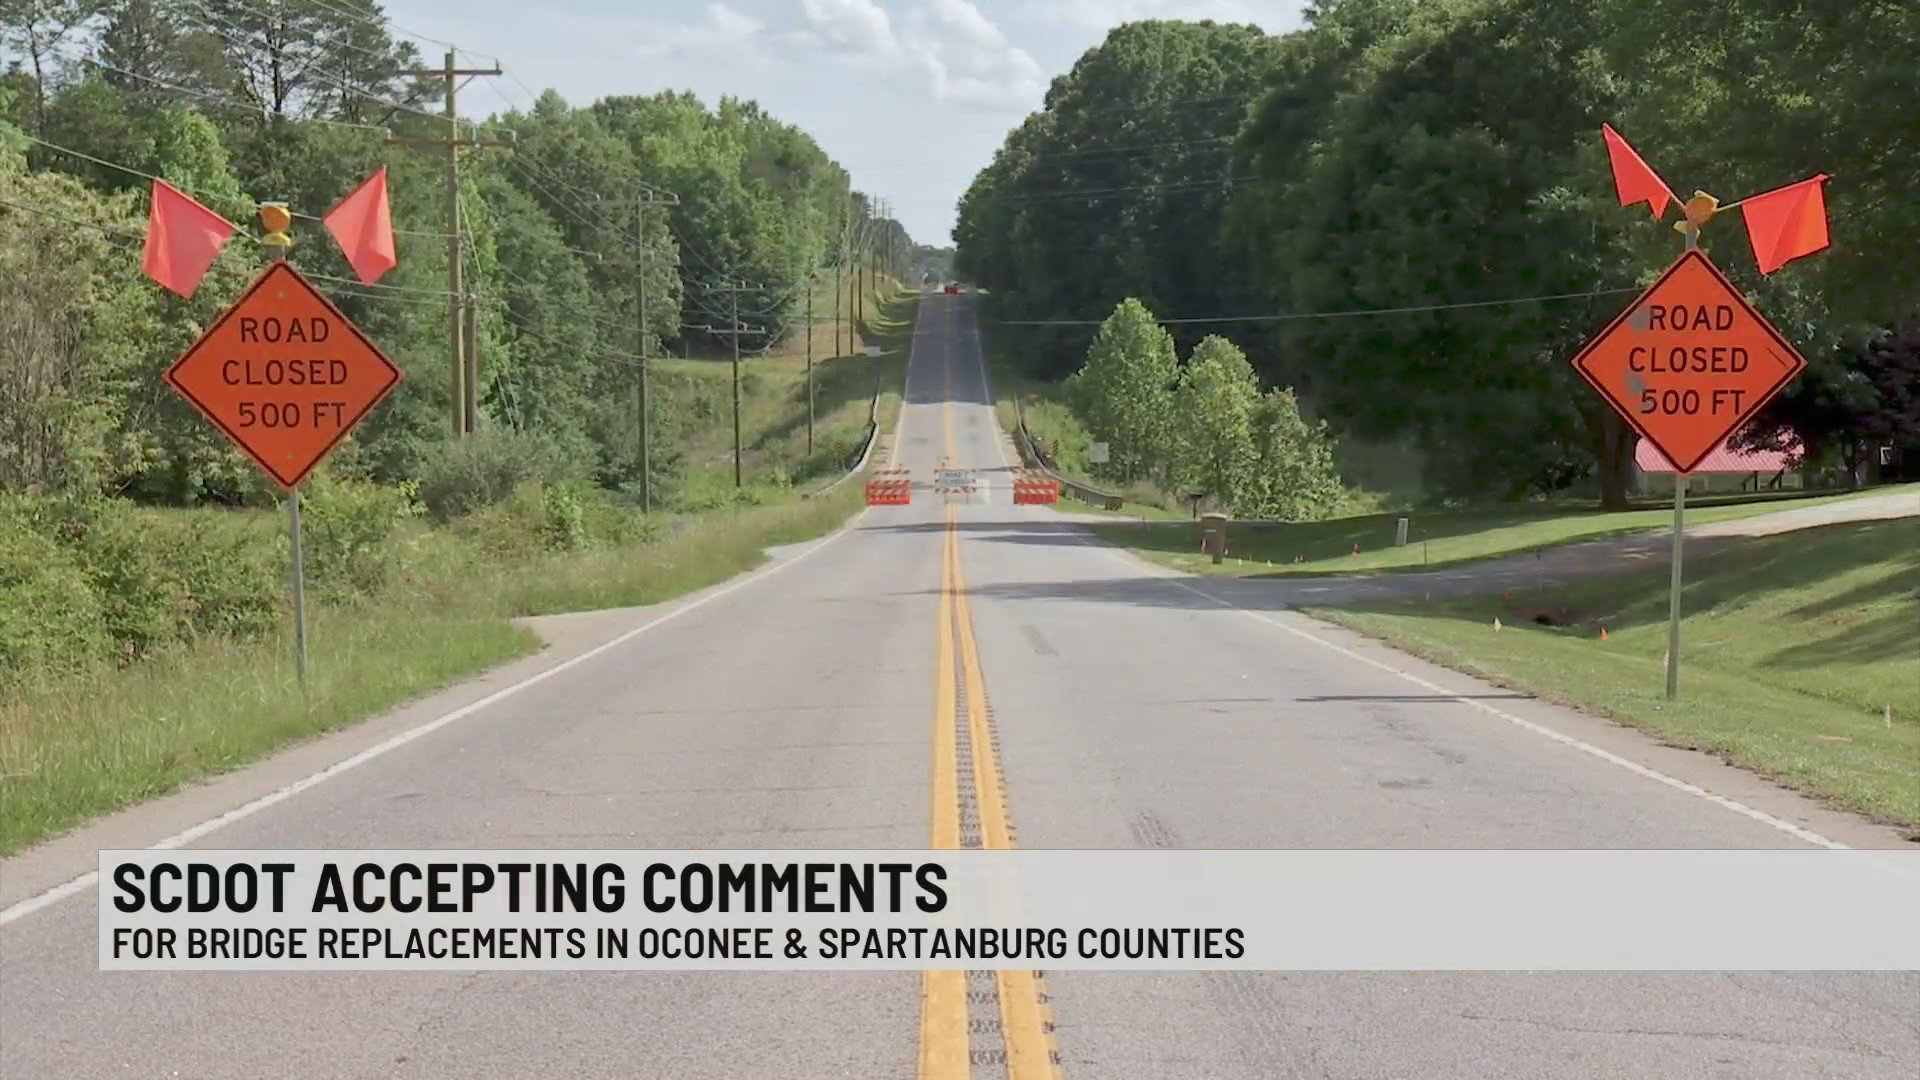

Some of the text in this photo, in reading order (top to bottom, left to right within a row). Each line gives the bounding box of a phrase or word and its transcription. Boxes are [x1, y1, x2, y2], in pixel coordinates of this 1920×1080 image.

[240, 317, 330, 343] ROAD
[1649, 304, 1734, 331] ROAD
[222, 359, 348, 386] CLOSED
[1628, 346, 1749, 373] CLOSED
[238, 402, 347, 428] 500 FT
[1639, 389, 1746, 416] 500 FT
